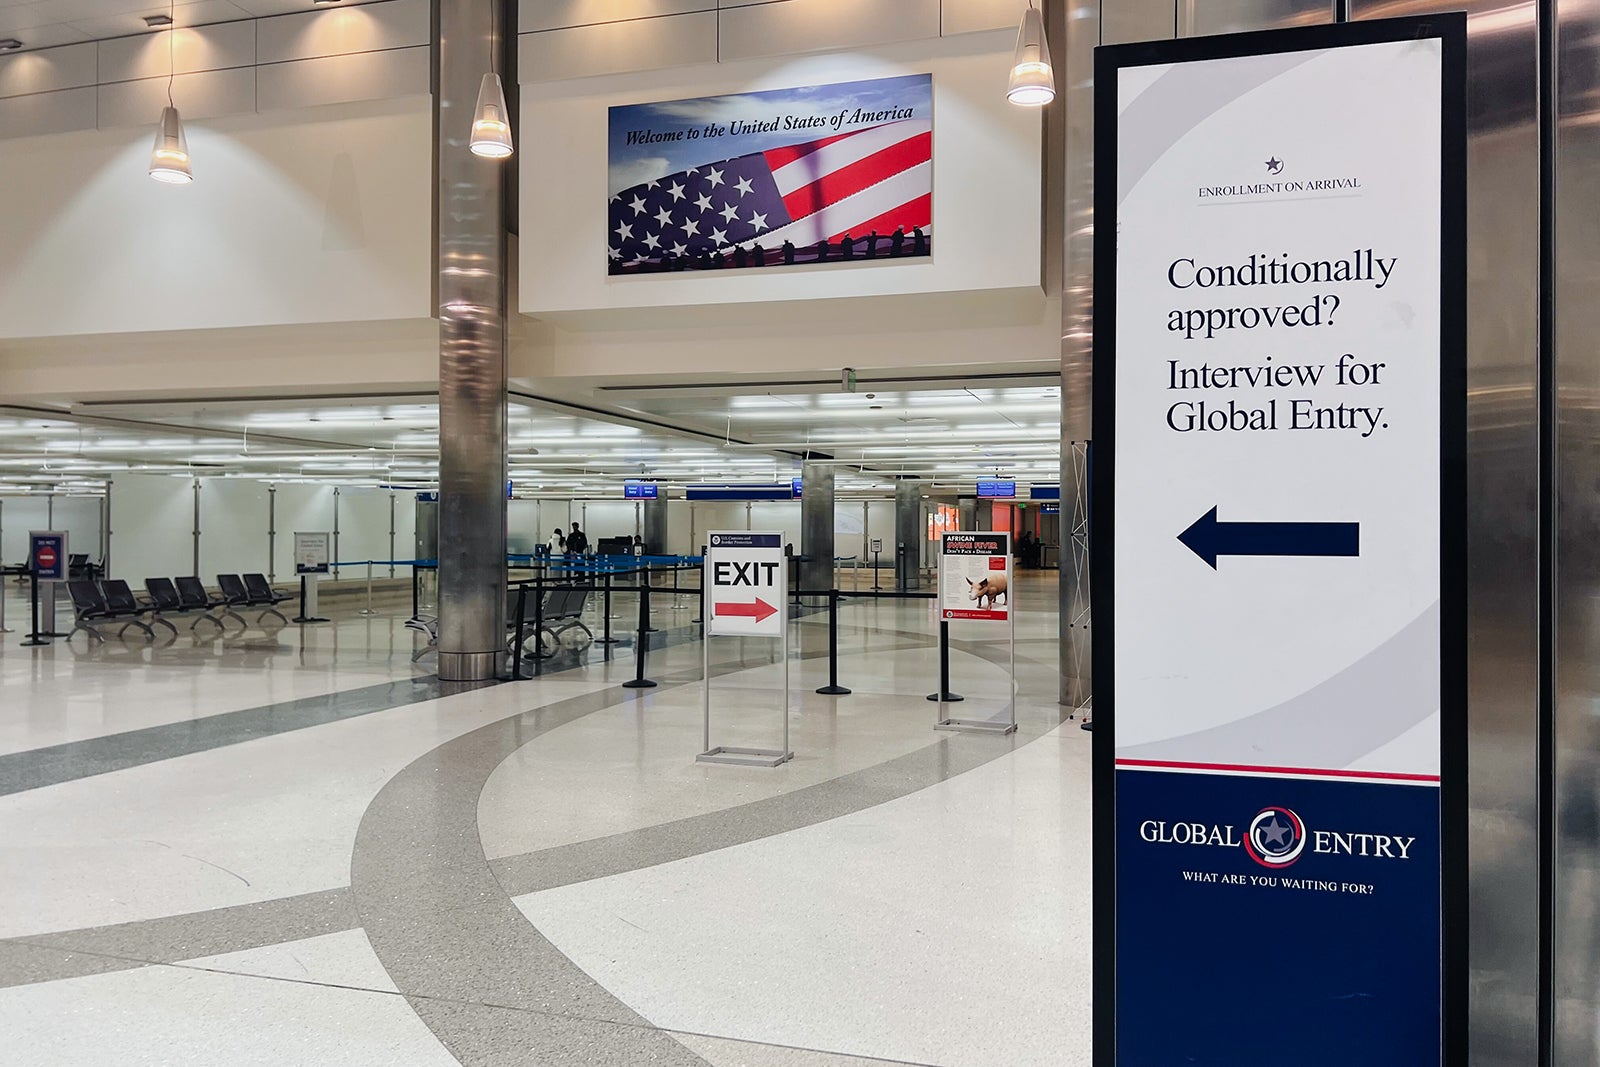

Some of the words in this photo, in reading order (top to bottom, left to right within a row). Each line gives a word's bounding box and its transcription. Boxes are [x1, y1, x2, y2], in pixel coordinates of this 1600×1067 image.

[625, 129, 683, 146] Welcome
[687, 128, 699, 140] to
[703, 123, 725, 138] the
[730, 114, 780, 135] United
[783, 109, 826, 129] States
[830, 109, 850, 128] of
[847, 105, 914, 124] America
[1199, 182, 1282, 197] ENROLLMENT
[1285, 181, 1304, 193] ON
[1305, 177, 1361, 191] ARRIVAL
[1167, 248, 1397, 289] Conditionally
[1167, 294, 1341, 340] approved?
[1166, 356, 1325, 390] Interview
[1335, 353, 1386, 386] for
[1166, 399, 1279, 432] Global
[1288, 399, 1389, 438] Entry.
[974, 542, 998, 550] FEVER
[714, 562, 779, 586] EXIT
[1140, 820, 1241, 847] GLOBAL
[1313, 831, 1415, 859] ENTRY
[1182, 871, 1219, 883] WHAT
[1221, 874, 1246, 885] ARE
[1249, 876, 1278, 888] YOU
[1281, 878, 1338, 892] WAITING
[1341, 883, 1374, 895] FOR?
